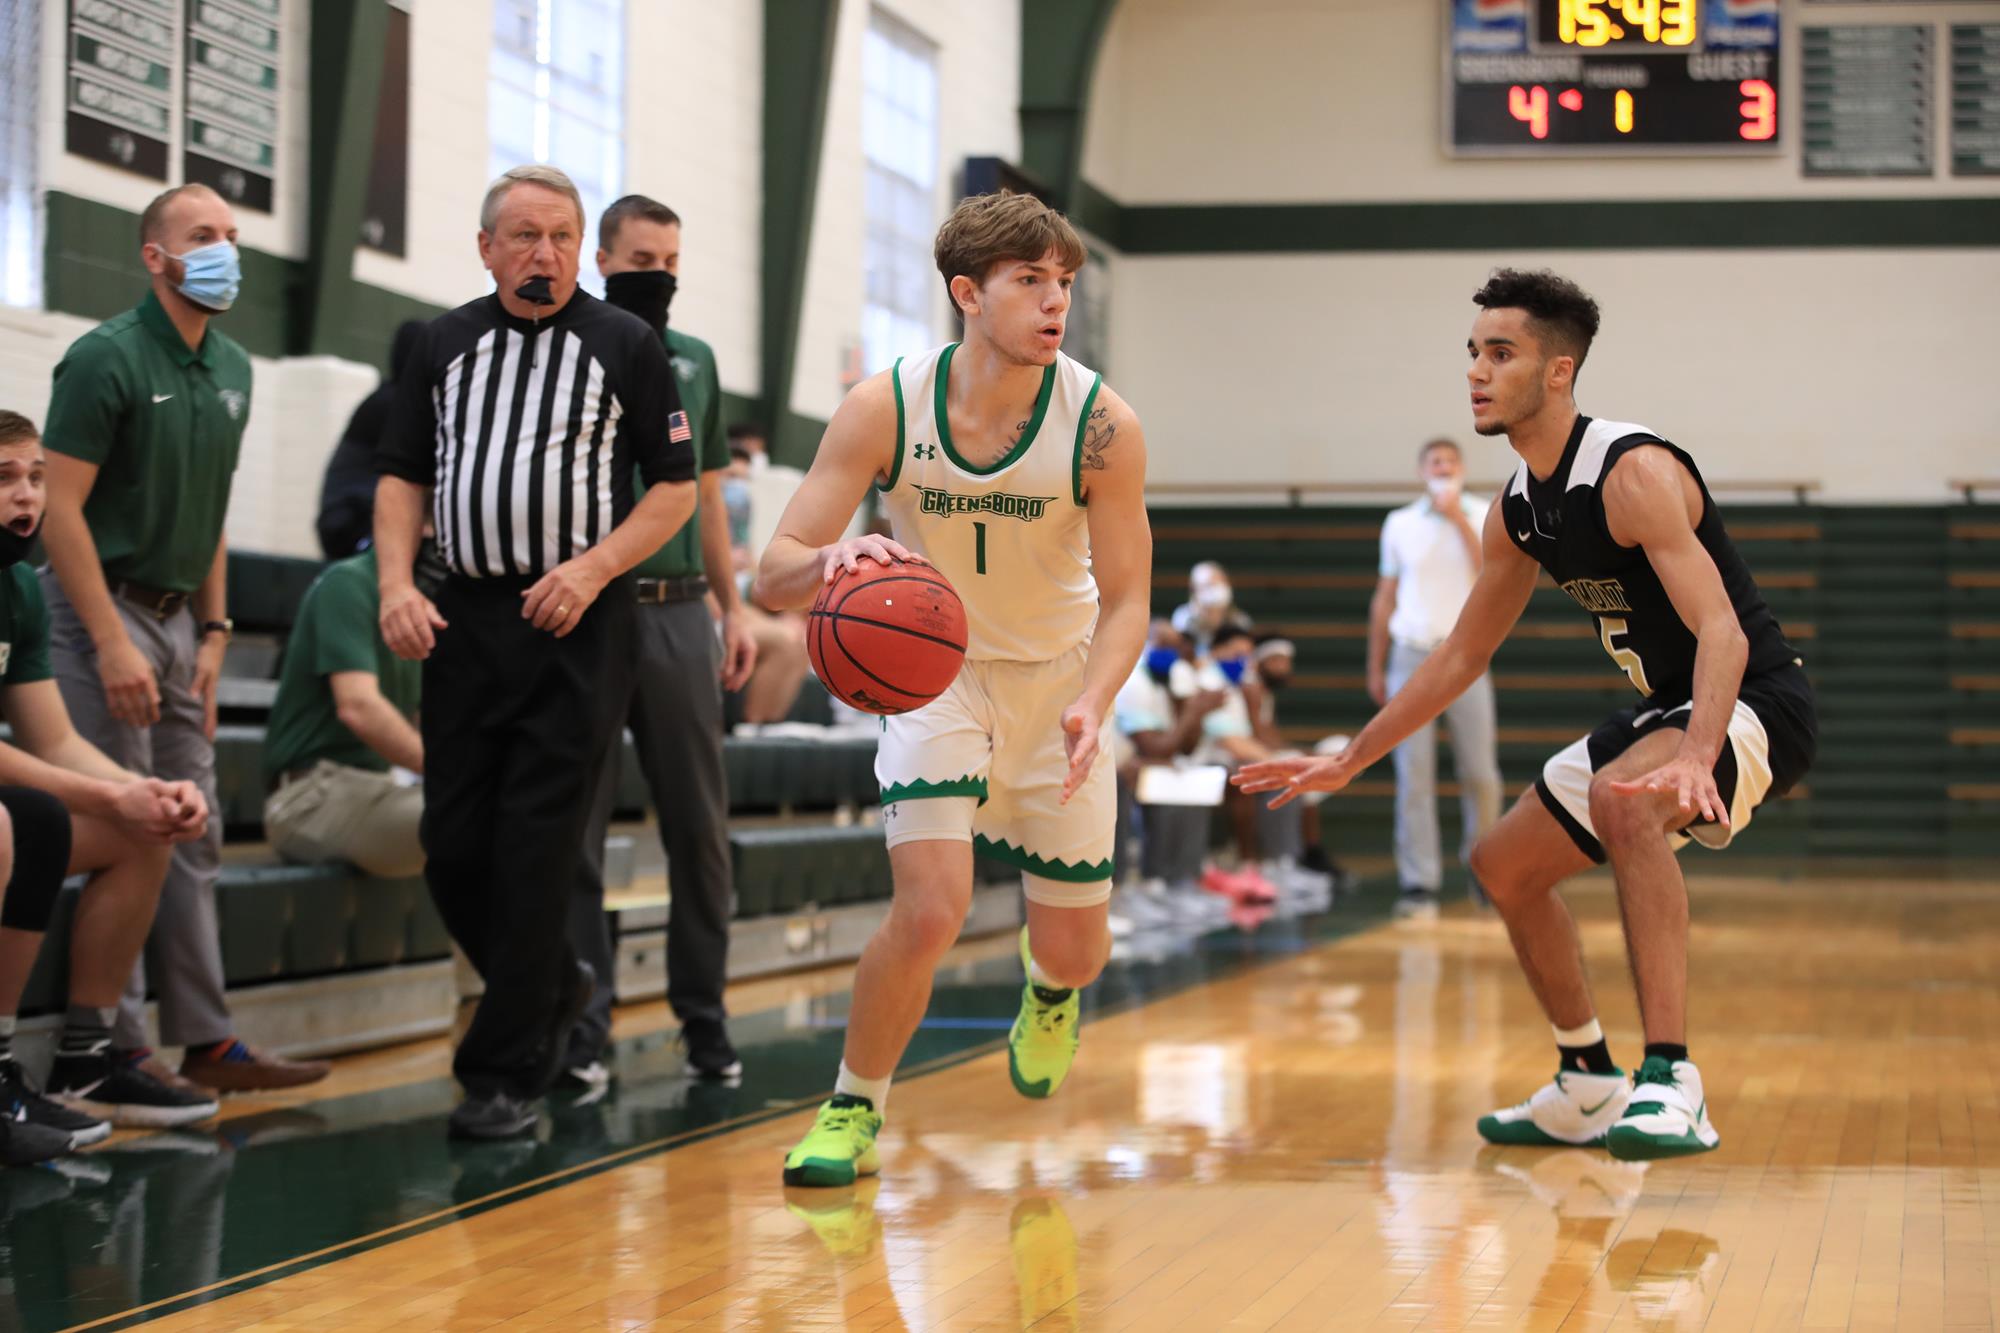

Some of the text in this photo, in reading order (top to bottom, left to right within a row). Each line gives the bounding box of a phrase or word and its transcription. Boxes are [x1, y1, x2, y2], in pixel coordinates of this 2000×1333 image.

[1559, 0, 1696, 46] 15:43
[1688, 53, 1770, 80] GUEST
[1509, 85, 1548, 139] 4
[1615, 89, 1633, 133] 1
[1739, 79, 1776, 140] 3
[920, 487, 1046, 521] GREENSBORO
[973, 521, 987, 575] 1
[1599, 616, 1656, 698] 5
